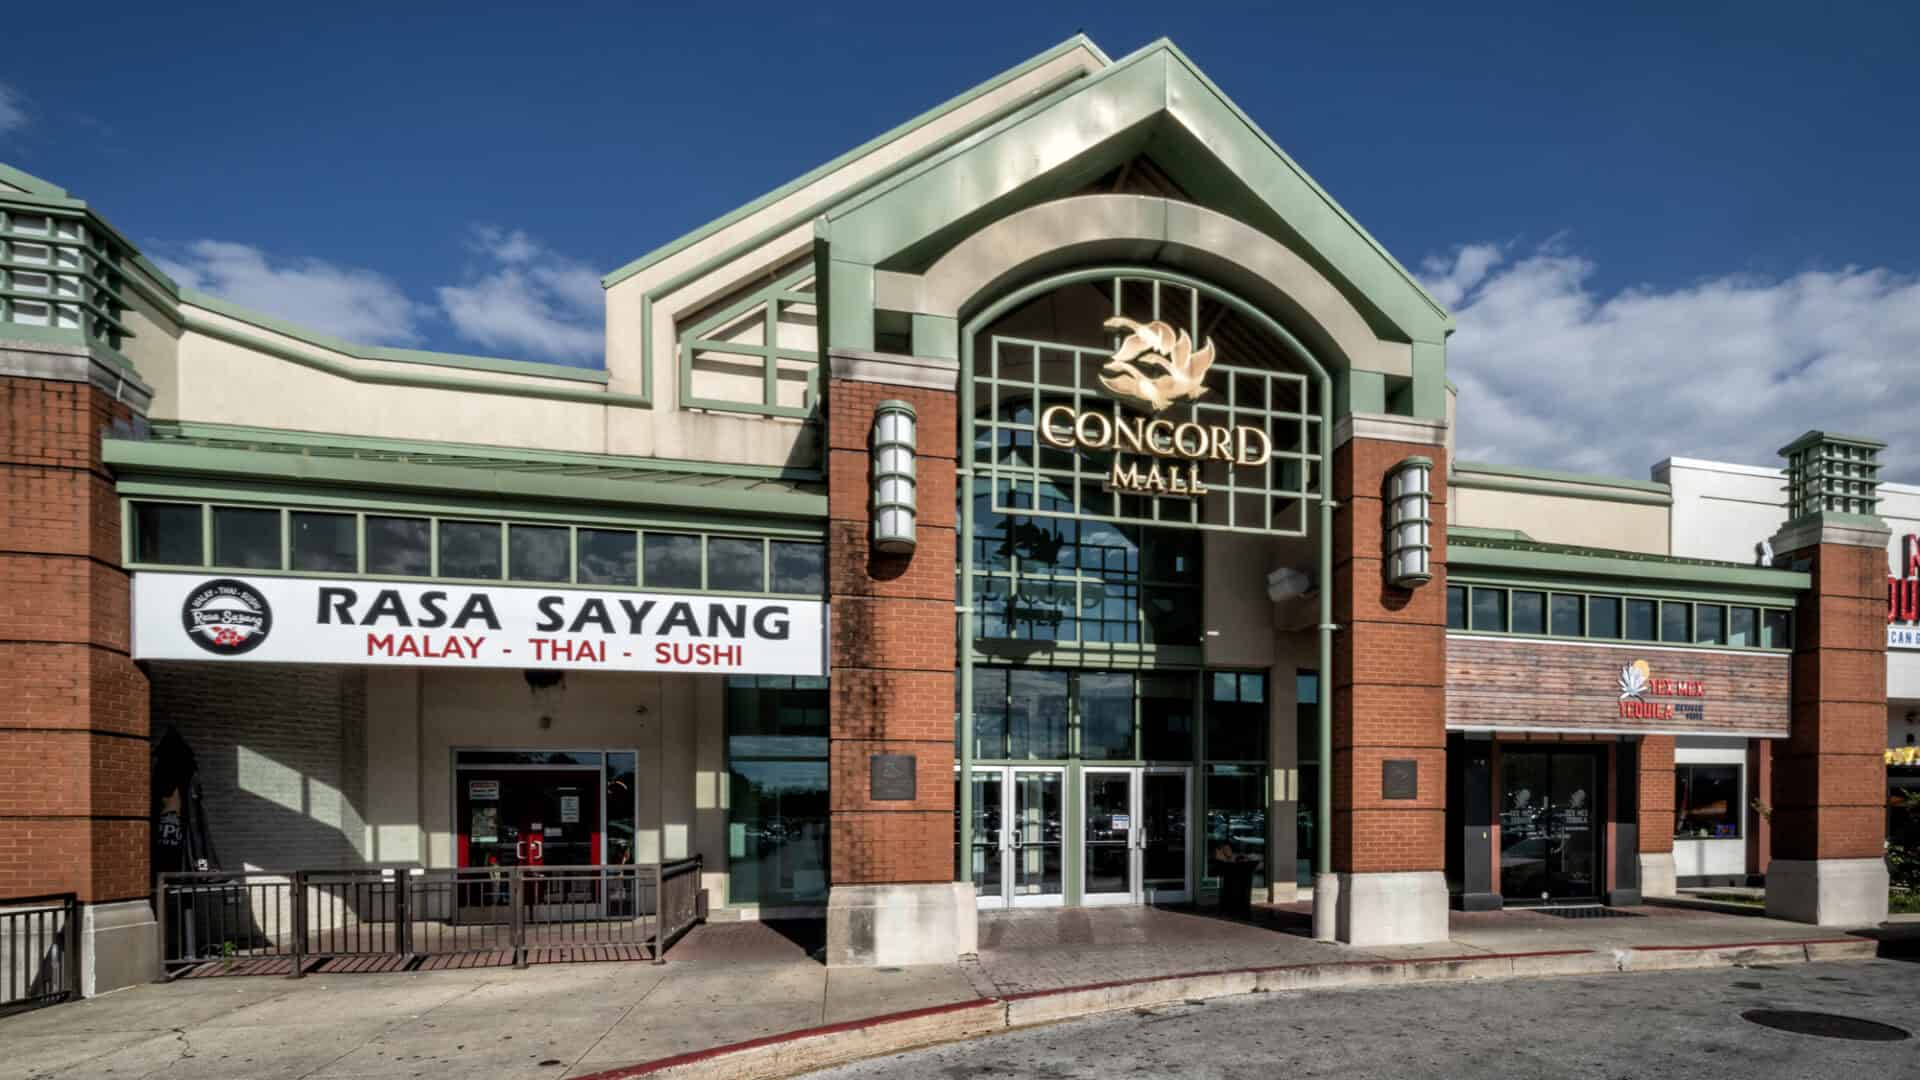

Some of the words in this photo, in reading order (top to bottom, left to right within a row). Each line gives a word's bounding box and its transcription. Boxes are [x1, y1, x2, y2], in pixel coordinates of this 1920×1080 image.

[1041, 405, 1272, 466] CONCORD
[1112, 462, 1208, 494] MALL
[317, 587, 502, 630] RASA
[536, 596, 790, 640] SAYANG
[367, 633, 486, 659] MALAY
[528, 639, 606, 662] THAI
[655, 642, 743, 666] SUSHI
[1617, 701, 1673, 720] TEQUILA
